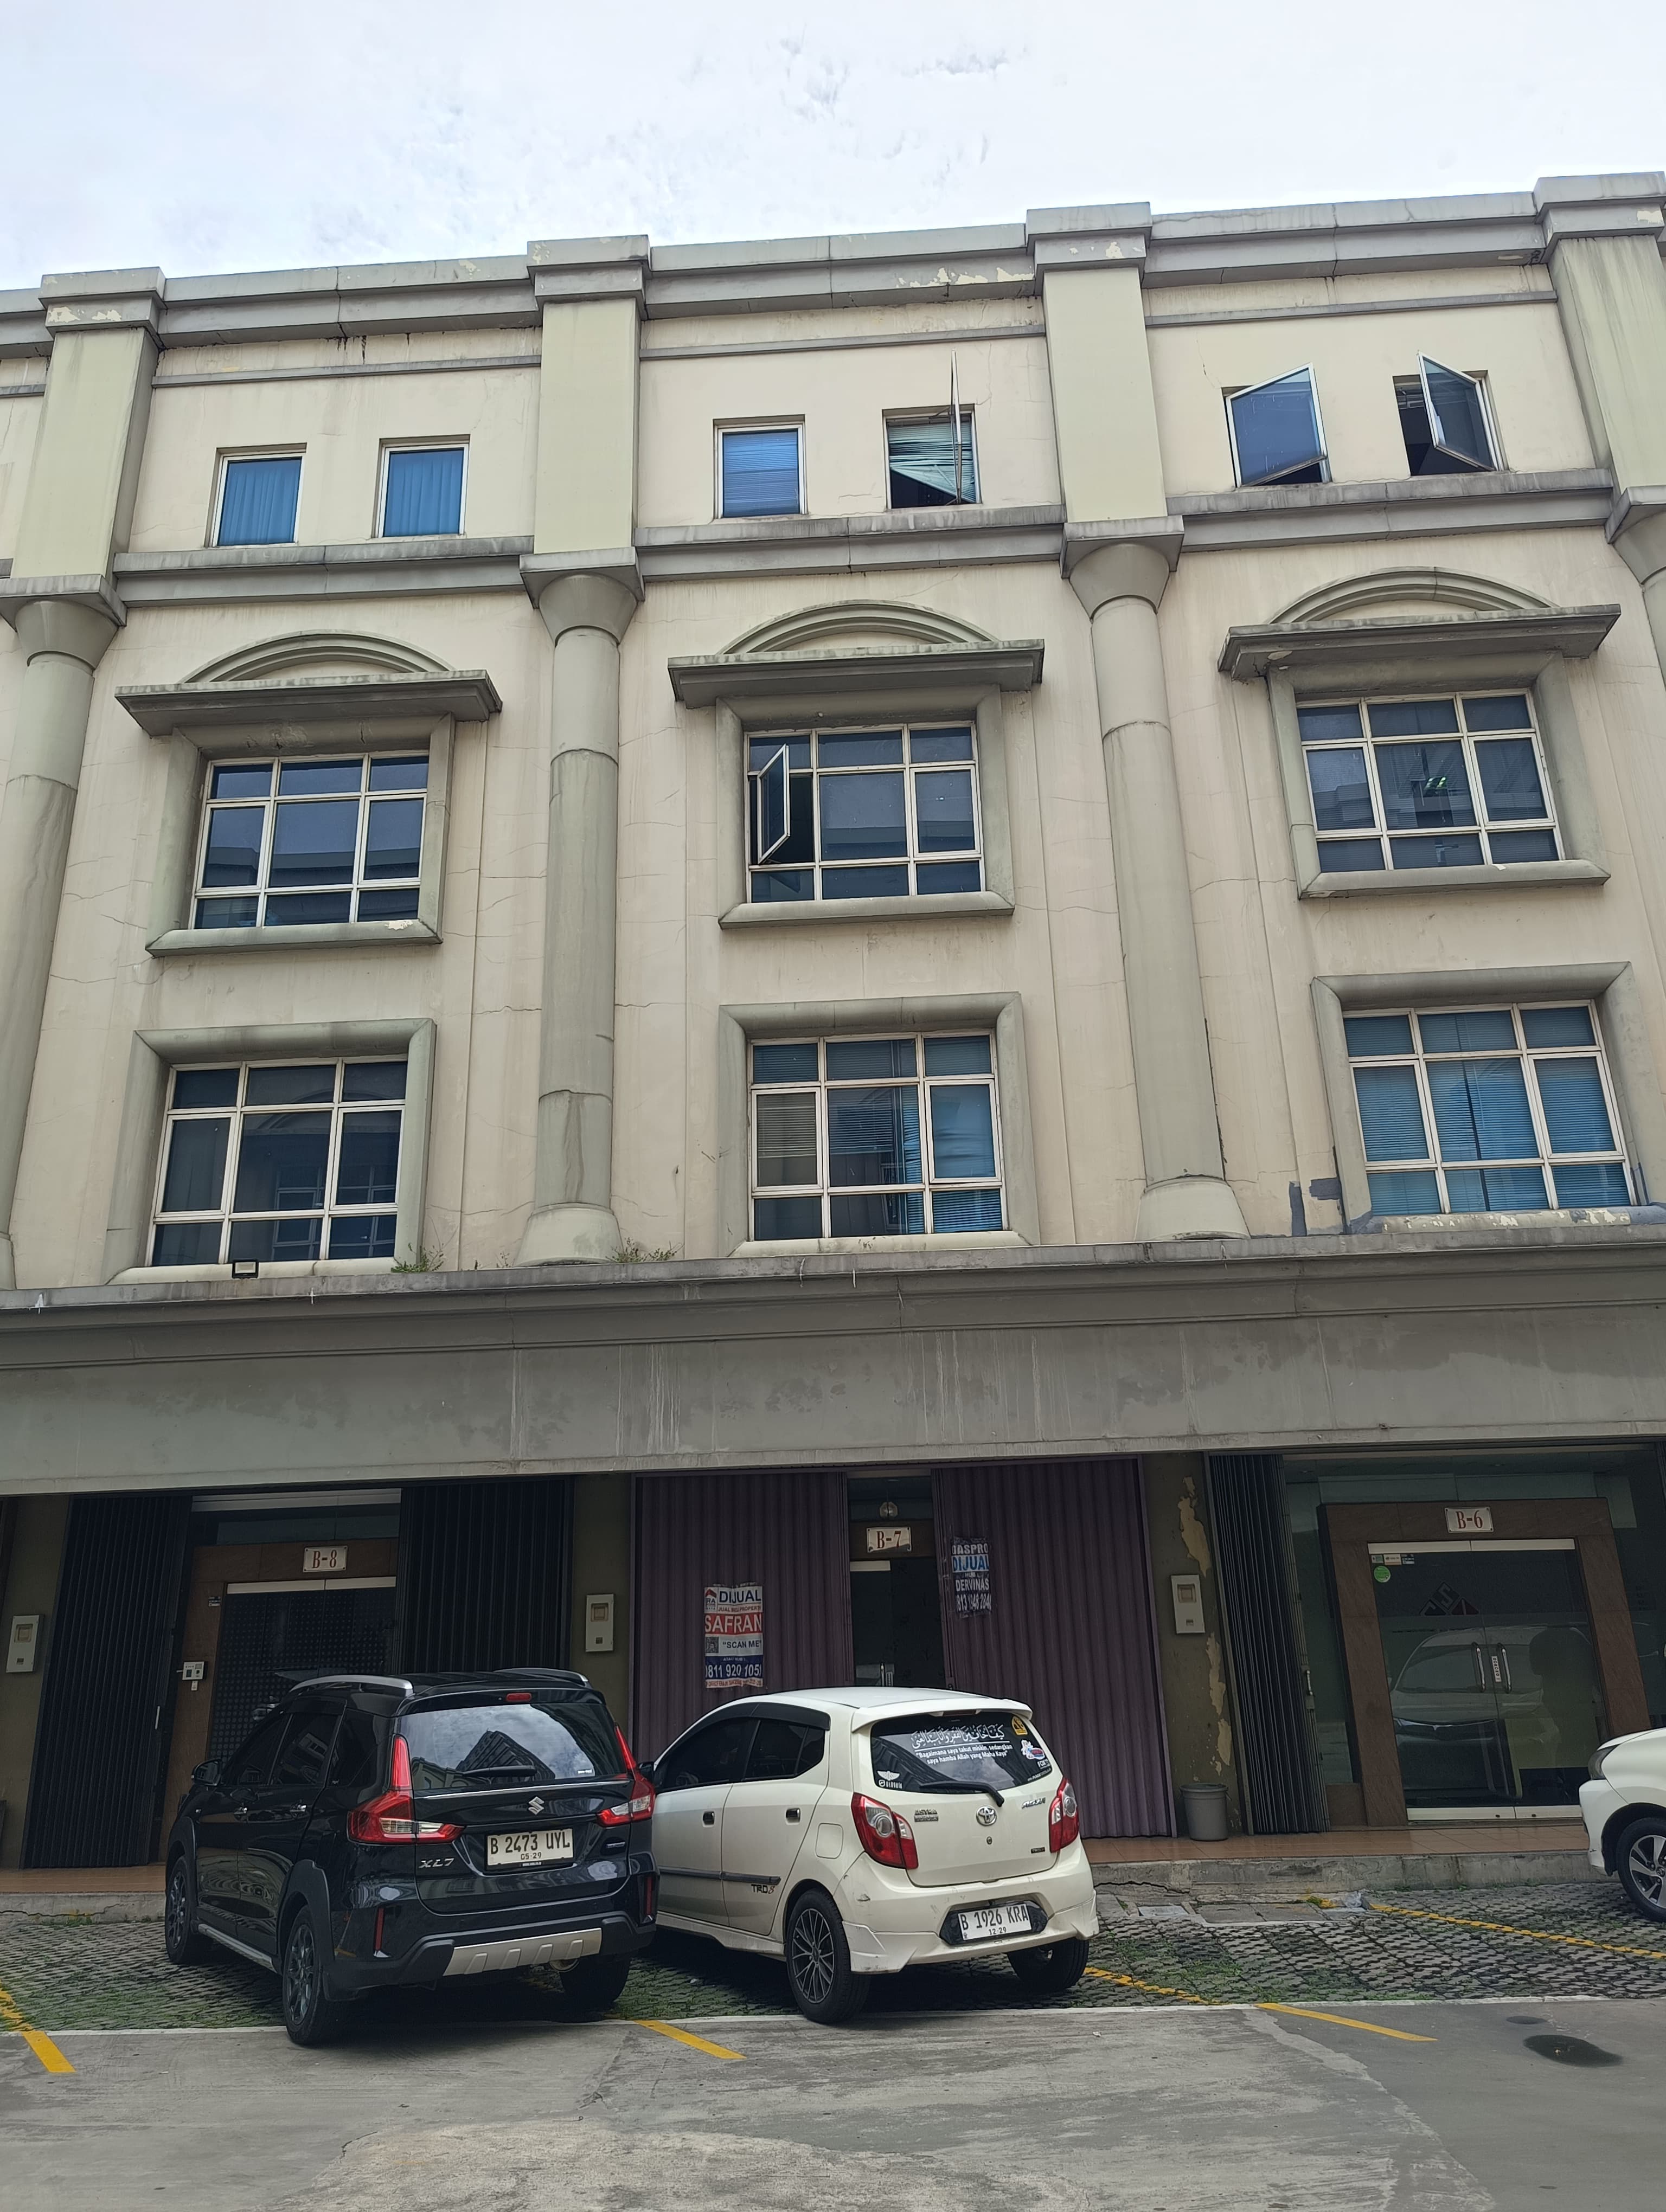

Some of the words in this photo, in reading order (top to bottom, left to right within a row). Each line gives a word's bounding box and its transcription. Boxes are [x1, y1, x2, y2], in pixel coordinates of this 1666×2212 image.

[1456, 1510, 1483, 1529] B-6
[876, 1531, 901, 1549] B-7
[312, 1549, 337, 1568] B-8
[953, 1555, 990, 1571] DIJUAL
[956, 1578, 989, 1591] DERVINAS
[719, 1590, 761, 1603] DIJUAL
[956, 1594, 967, 1611] 813
[705, 1614, 762, 1634] SAFRAN
[726, 1664, 742, 1677] 920
[490, 1837, 498, 1855] B
[505, 1834, 538, 1853] 2473
[546, 1831, 570, 1850] UYL
[419, 1857, 454, 1868] XL7
[960, 1914, 969, 1930] B
[974, 1909, 1003, 1928] 1926
[1006, 1905, 1028, 1924] KRA
